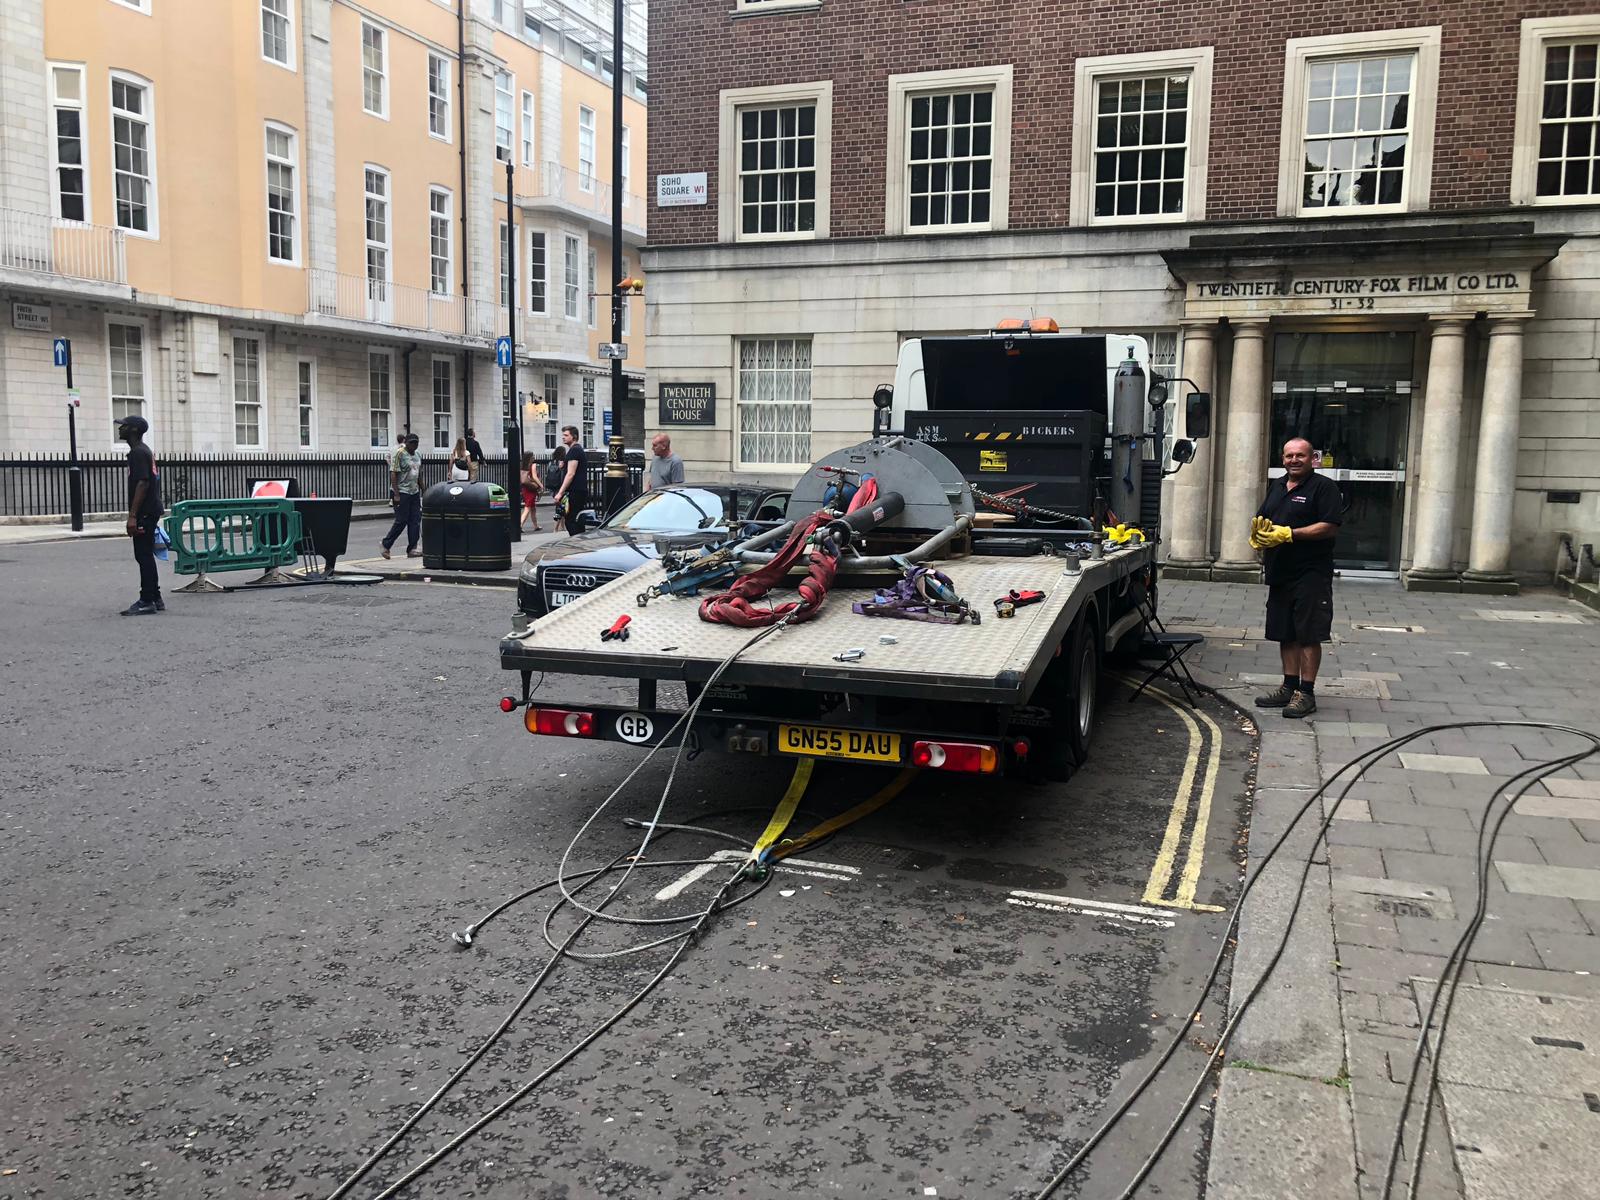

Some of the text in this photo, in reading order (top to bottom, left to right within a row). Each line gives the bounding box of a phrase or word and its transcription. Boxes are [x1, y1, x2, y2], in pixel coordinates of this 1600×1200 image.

[661, 177, 682, 186] SOHO
[661, 185, 704, 196] SQUARE W1
[1197, 282, 1286, 296] TWENTIETH
[1408, 276, 1449, 292] FILM
[1457, 275, 1480, 290] CO
[663, 387, 711, 398] TWENTIETH
[666, 398, 708, 409] CENTURY
[672, 409, 702, 420] HOUSE
[1022, 426, 1075, 435] BICKERS
[620, 716, 648, 738] GB
[787, 726, 891, 755] GN55 DAU
